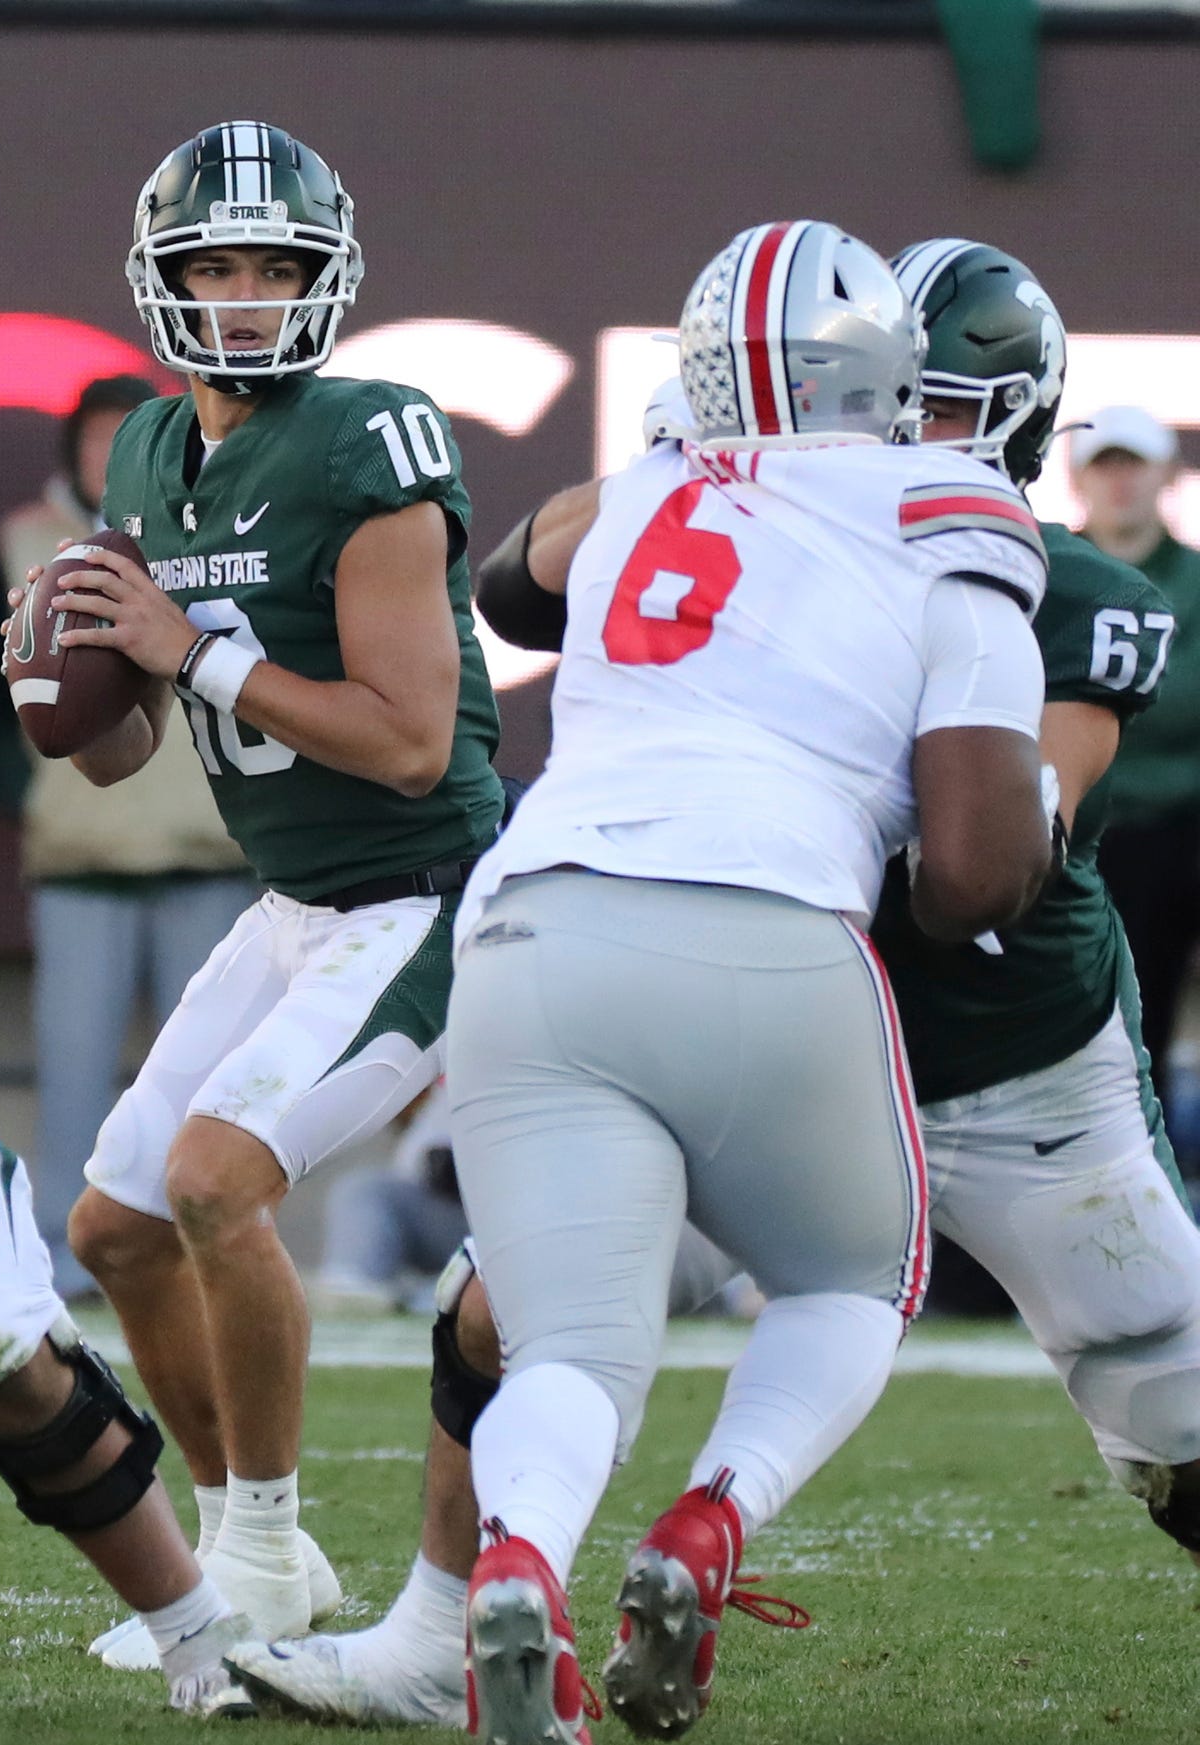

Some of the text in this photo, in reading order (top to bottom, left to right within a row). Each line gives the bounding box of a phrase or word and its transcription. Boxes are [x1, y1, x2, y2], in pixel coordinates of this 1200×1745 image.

[229, 206, 269, 220] STATE
[157, 286, 181, 330] SPTANS
[295, 280, 326, 323] SPATANS
[365, 403, 452, 489] 10
[147, 550, 270, 592] CHIGAN STATE
[601, 475, 743, 667] 6
[1089, 607, 1176, 695] 67
